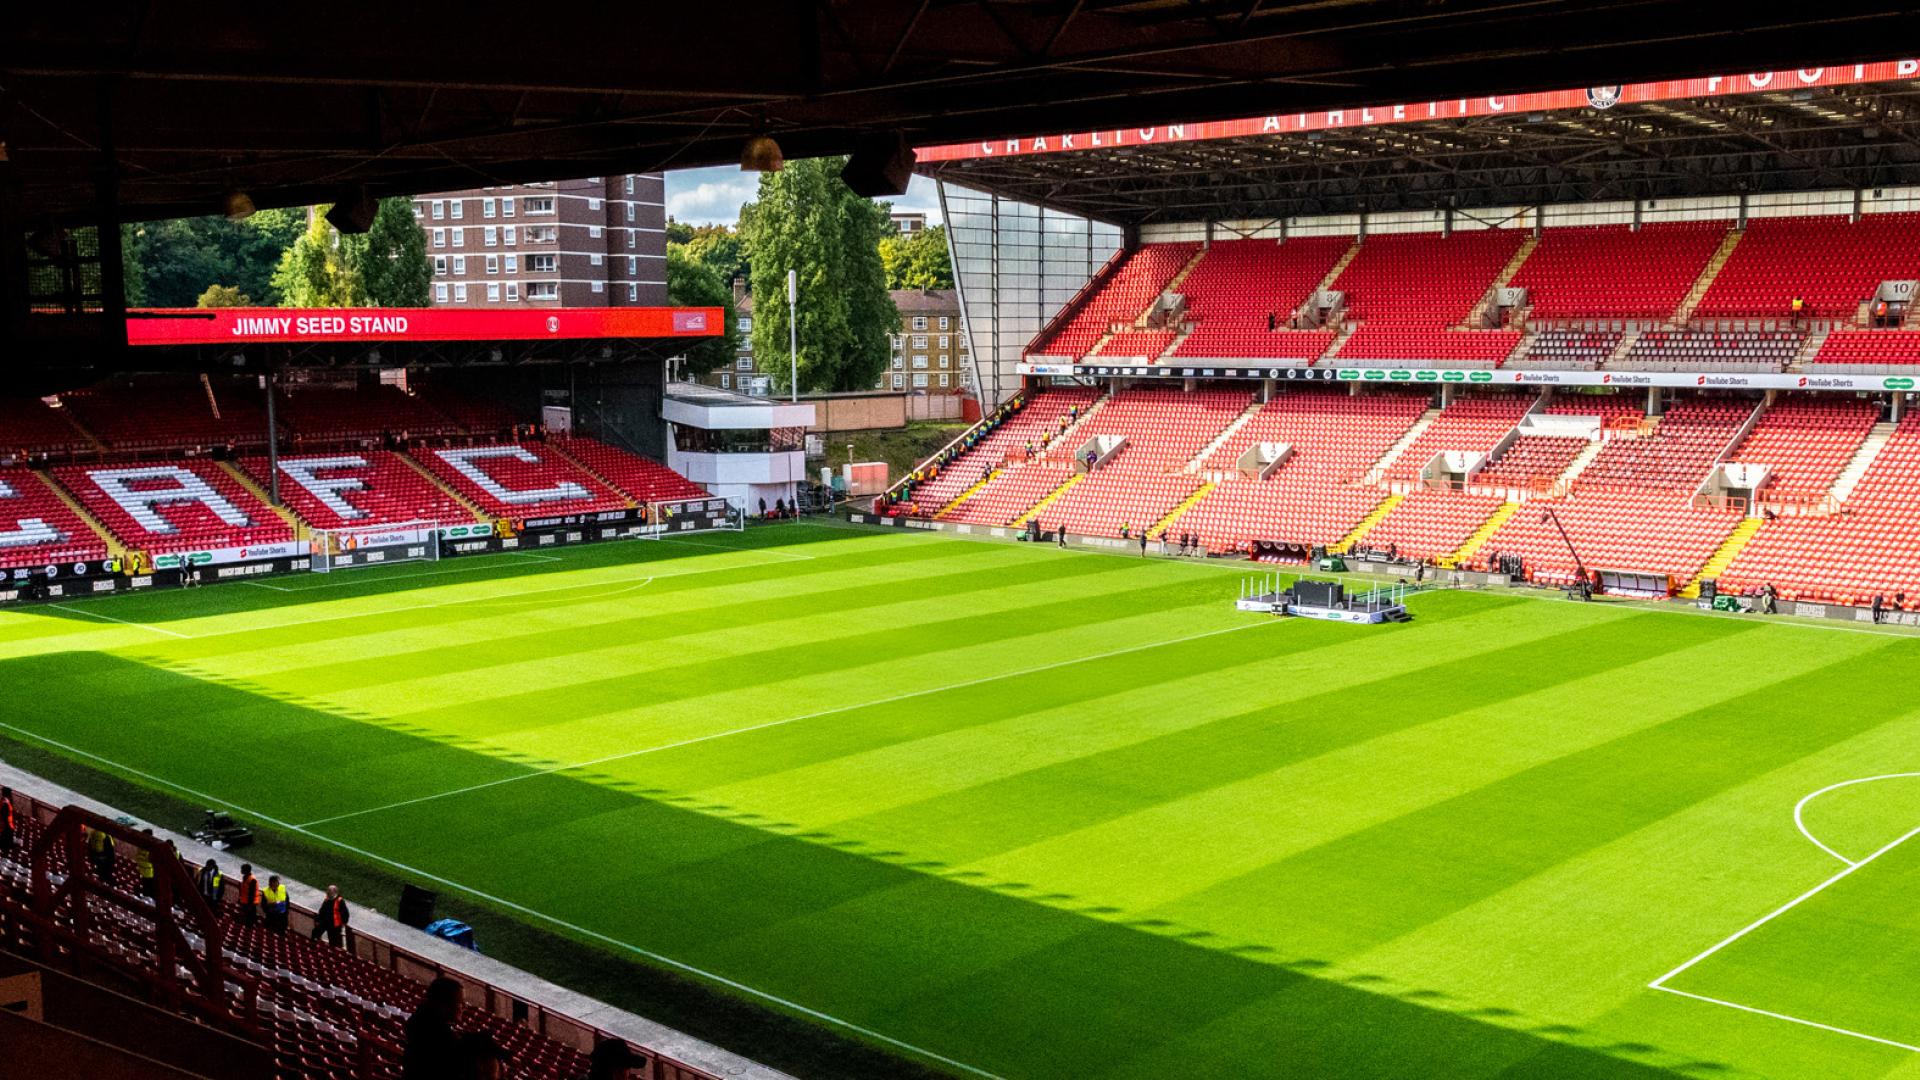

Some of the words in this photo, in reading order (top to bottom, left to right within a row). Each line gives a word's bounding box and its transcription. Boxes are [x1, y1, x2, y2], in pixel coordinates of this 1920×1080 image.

[1894, 283, 1909, 294] 10
[1507, 289, 1514, 299] 9
[232, 317, 292, 335] JIMMY
[297, 317, 345, 334] SEED
[350, 316, 408, 333] STAND
[1612, 375, 1632, 383] YouTube
[1633, 375, 1650, 383] Shorts
[1706, 377, 1728, 385] YouTube
[1729, 377, 1748, 386] Shorts
[1808, 379, 1832, 387] YouTube
[1833, 379, 1853, 388] Shorts
